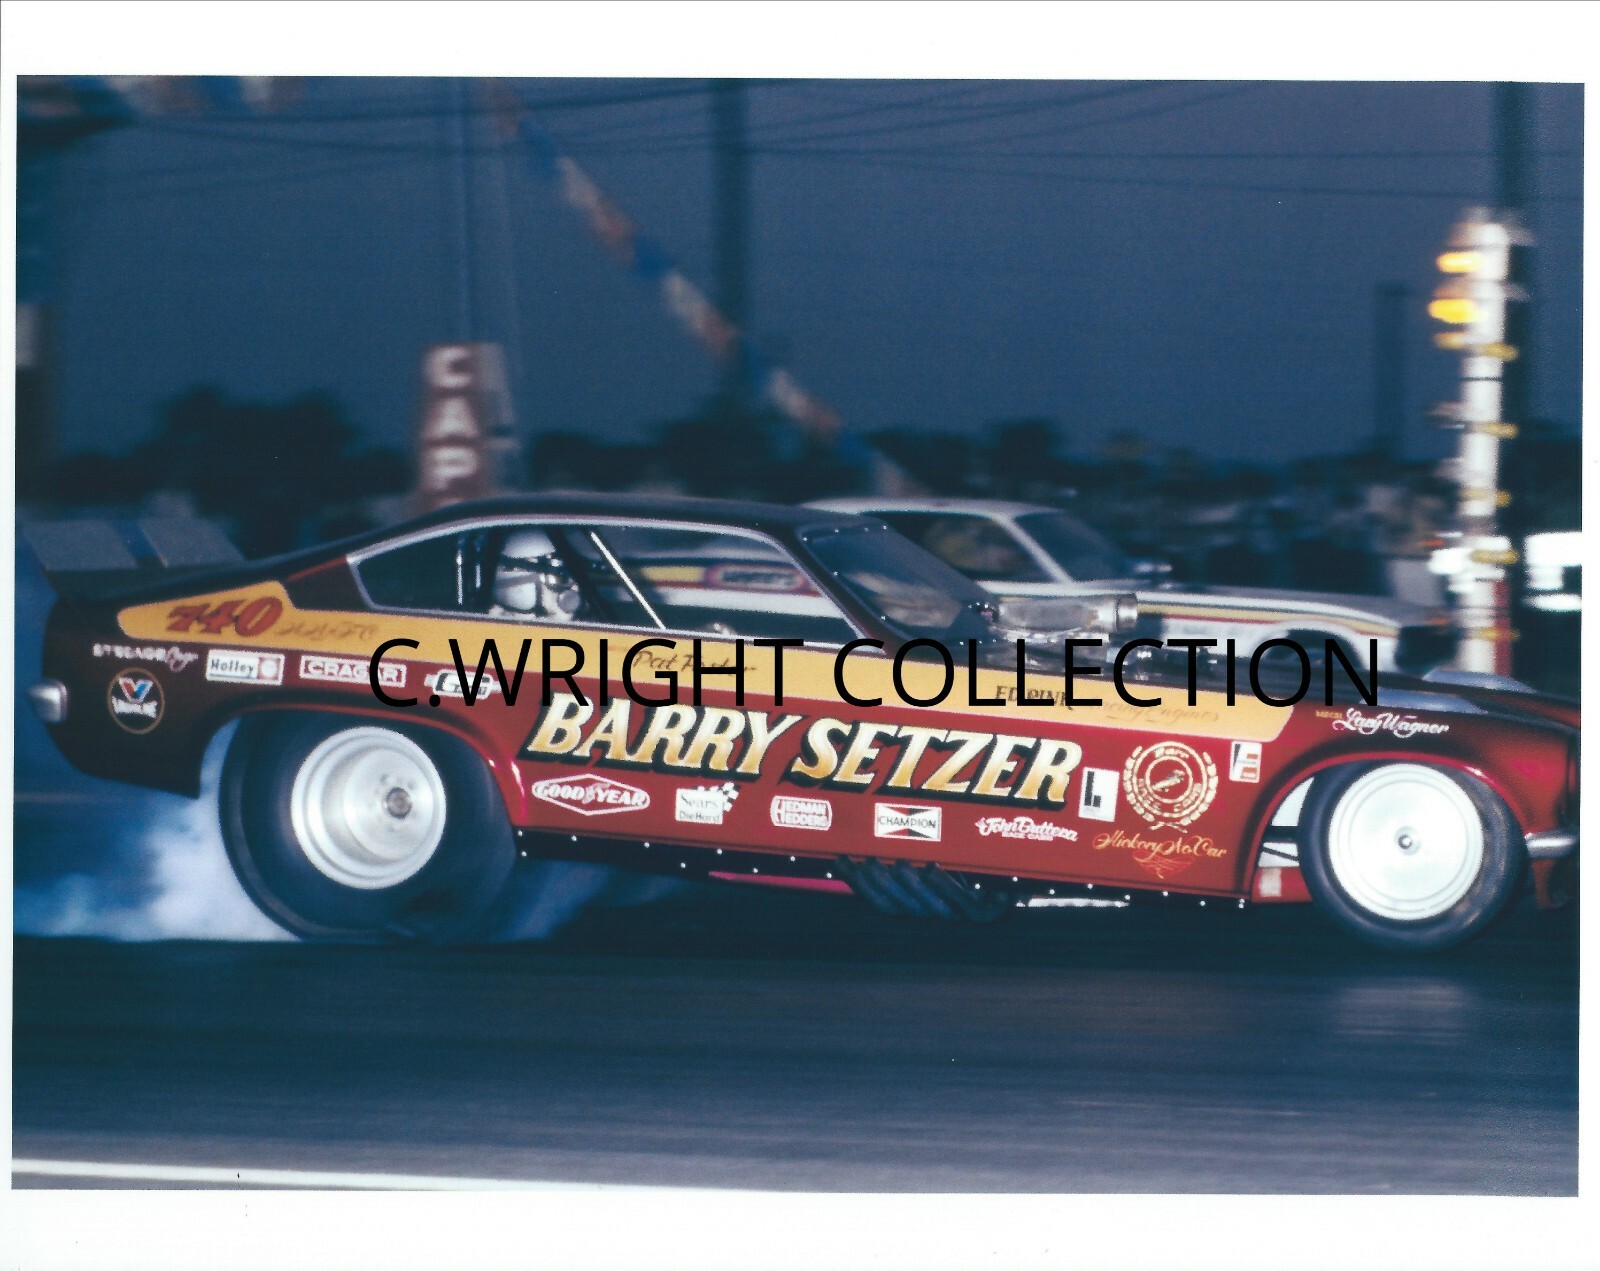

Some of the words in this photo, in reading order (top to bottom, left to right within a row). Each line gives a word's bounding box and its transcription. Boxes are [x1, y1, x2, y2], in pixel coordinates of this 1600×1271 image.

[166, 596, 284, 638] 740
[210, 658, 254, 673] Holley
[526, 693, 803, 776] BARRY
[792, 717, 1083, 803] SETZER
[680, 792, 719, 809] Sears
[879, 814, 937, 829] CHAMPION
